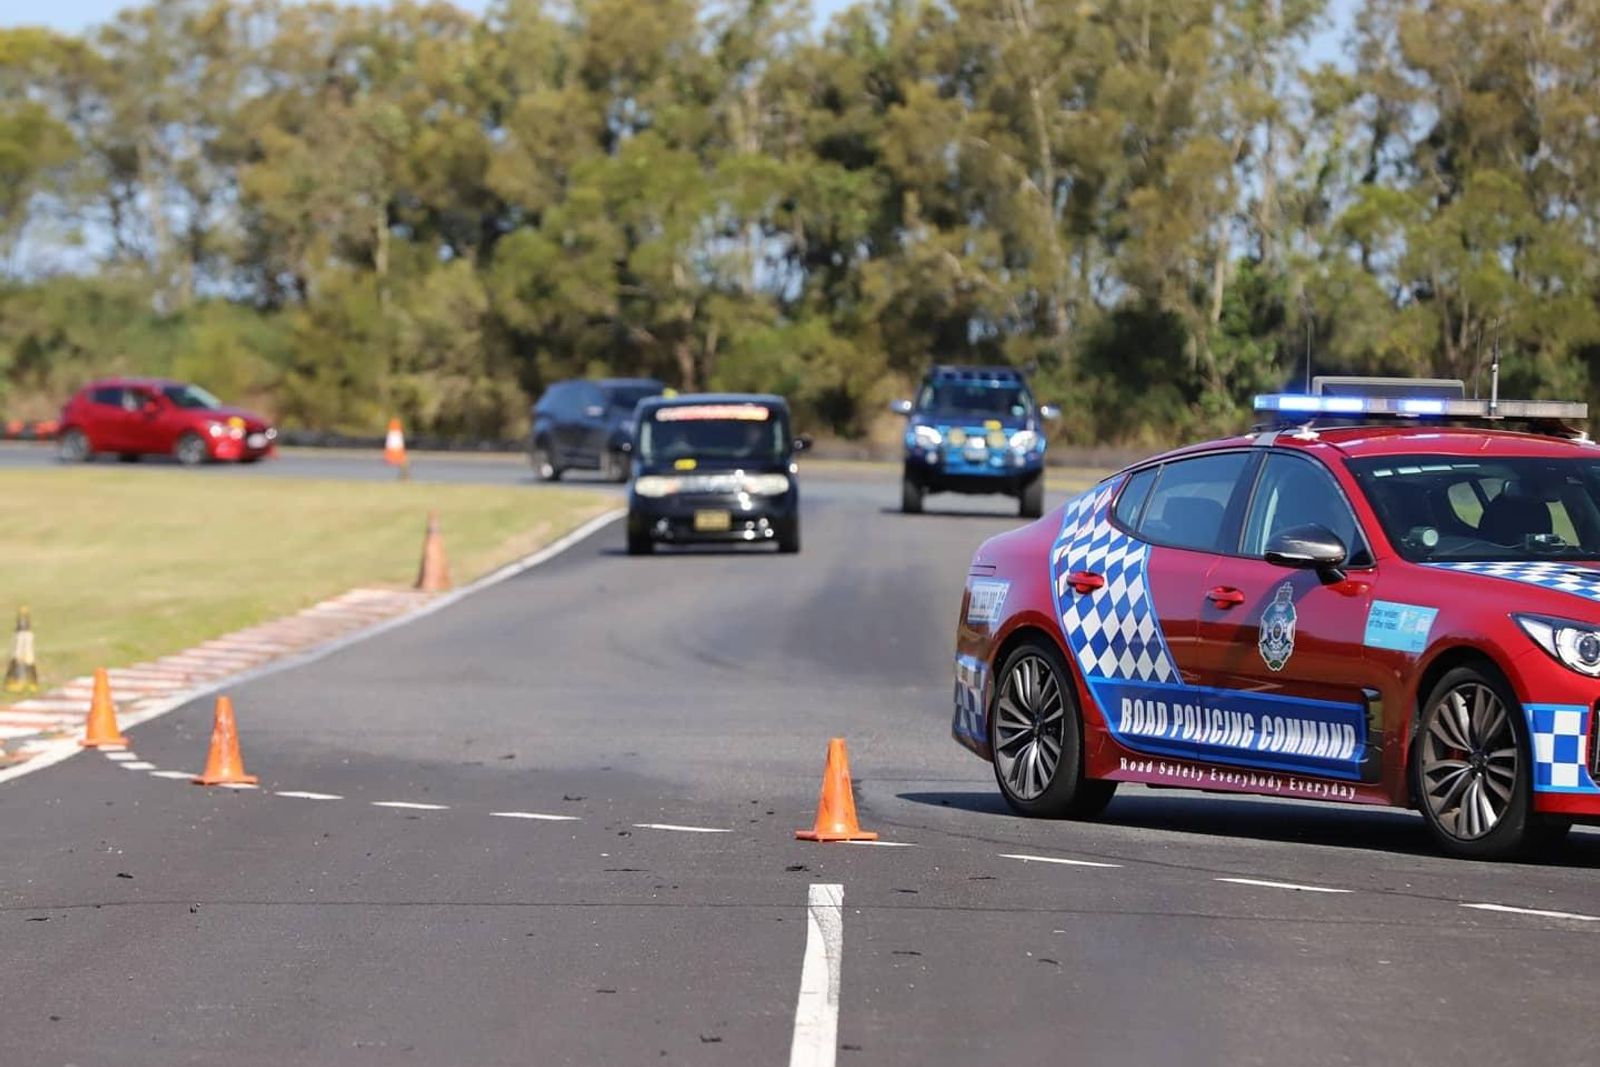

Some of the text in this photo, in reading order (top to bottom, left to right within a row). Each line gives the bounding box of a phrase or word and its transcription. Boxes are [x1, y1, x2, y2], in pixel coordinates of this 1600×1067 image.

[1118, 697, 1356, 759] ROAD POLICING COMMAND
[1120, 757, 1357, 800] Road Safety Everybody Everyday
